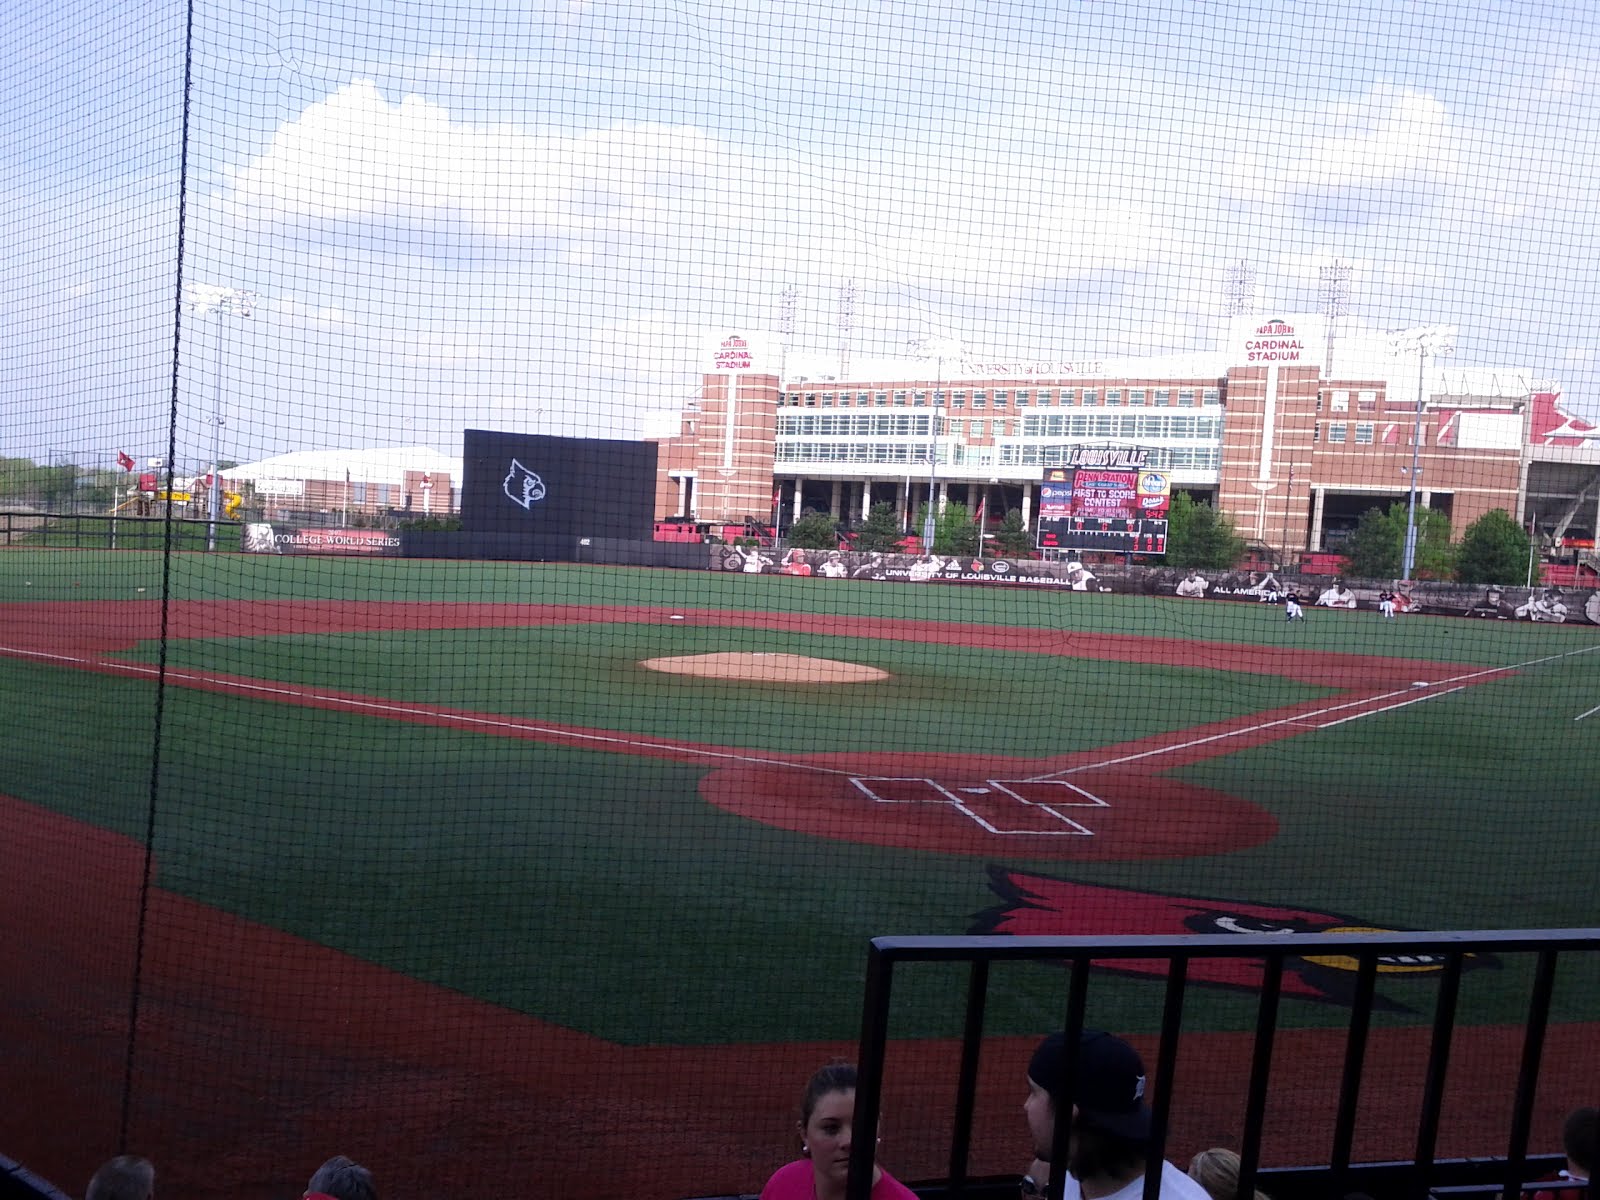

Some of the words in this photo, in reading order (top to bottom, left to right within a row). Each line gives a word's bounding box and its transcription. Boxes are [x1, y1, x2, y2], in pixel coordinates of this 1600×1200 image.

[1256, 325, 1272, 334] PAPA
[1245, 340, 1304, 350] CARDINAL
[713, 351, 753, 360] CARDINAL
[1248, 351, 1300, 361] STADIUM
[716, 361, 751, 369] STADIUM
[1070, 449, 1149, 467] LOUISVILLE
[1074, 470, 1101, 488] PENN
[1101, 471, 1138, 489] STATION
[1052, 490, 1072, 498] pepsi
[1073, 488, 1096, 498] FIRST
[1097, 490, 1107, 499] TO
[1108, 490, 1136, 500] SCORE
[1084, 498, 1121, 508] CONTEST
[274, 534, 322, 545] COLLEGE
[326, 535, 364, 546] WORLD
[366, 537, 400, 547] SERIES
[886, 569, 943, 579] UNIVERSITY
[961, 572, 1017, 582] LOUISVILLE
[1019, 576, 1071, 586] BASEBALL
[1213, 586, 1231, 595] ALL
[1233, 588, 1289, 598] AMERICN
